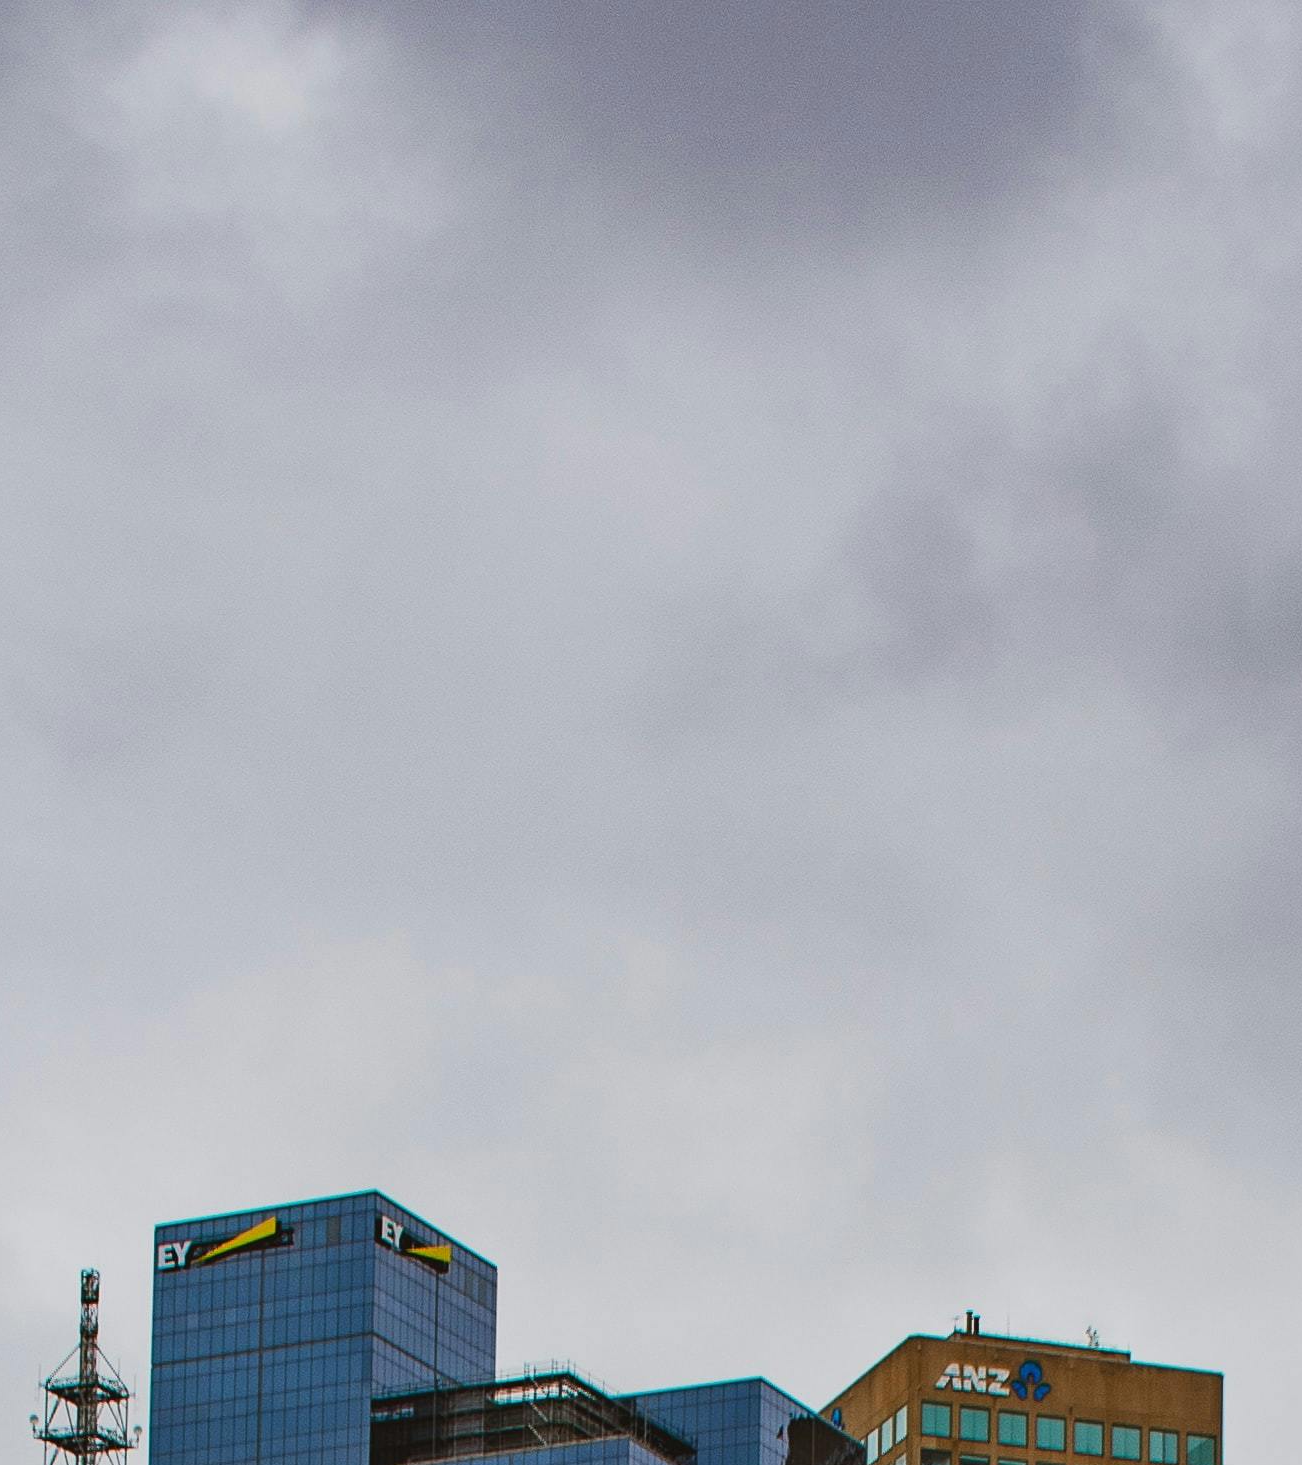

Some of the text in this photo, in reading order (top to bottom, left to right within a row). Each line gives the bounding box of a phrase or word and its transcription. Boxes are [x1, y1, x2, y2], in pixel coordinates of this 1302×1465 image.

[381, 1215, 404, 1249] EY
[157, 1241, 192, 1271] EY
[935, 1362, 1010, 1397] ANZ
